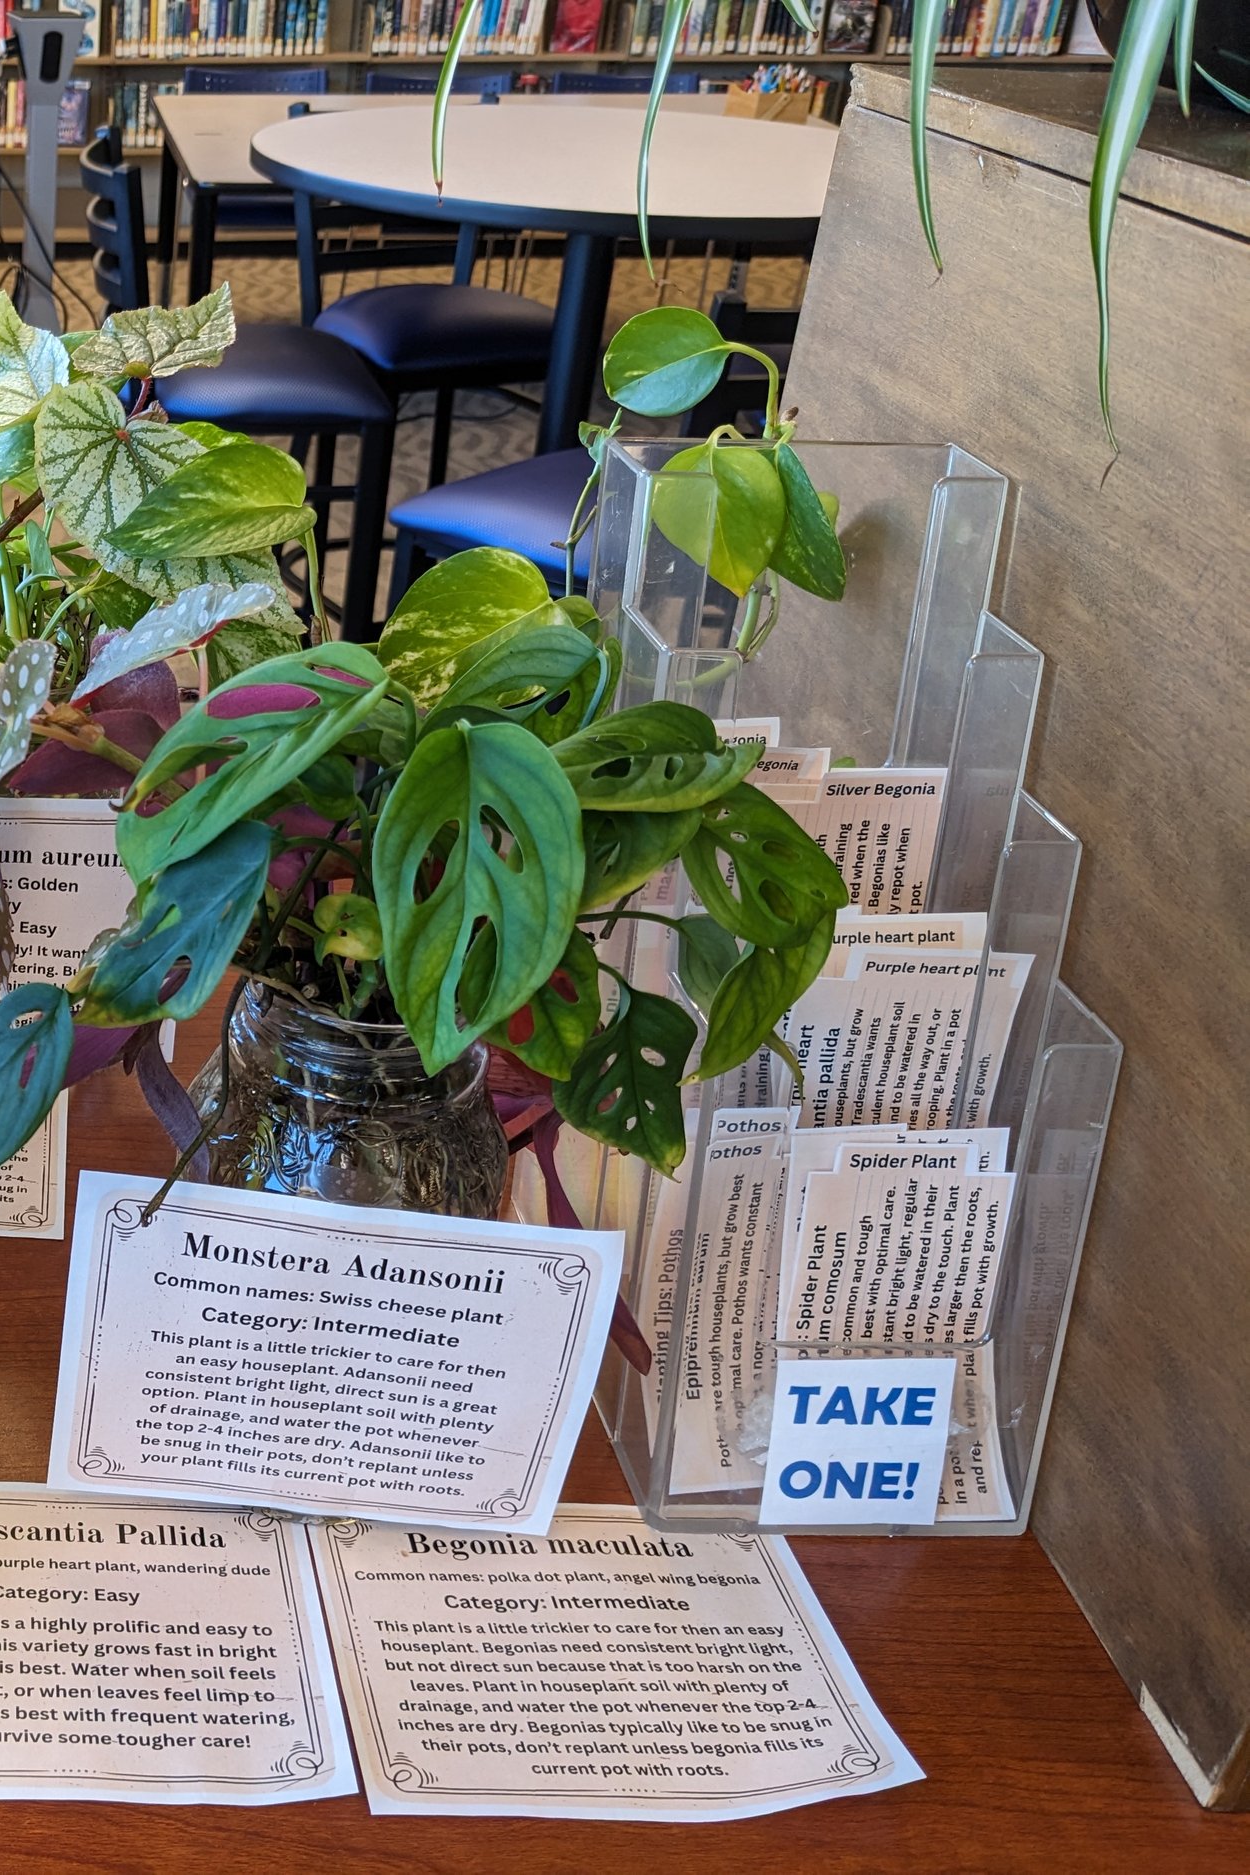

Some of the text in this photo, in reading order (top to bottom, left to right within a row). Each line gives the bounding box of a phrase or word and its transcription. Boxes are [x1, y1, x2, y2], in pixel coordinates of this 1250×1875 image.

[826, 782, 936, 799] Silver Begonia
[868, 823, 891, 907] Begonias like
[18, 877, 78, 893] Golden
[20, 921, 58, 938] Easy
[833, 929, 956, 947] urple heart plant
[865, 961, 1007, 977] Purple heart plnt
[818, 1027, 841, 1084] pallida
[717, 1119, 782, 1133] Pothos
[849, 1153, 958, 1172] Spider Plant
[16, 1185, 28, 1194] in
[180, 1231, 505, 1294] Monstera Adansonii
[860, 1186, 897, 1338] best with optimal care.
[923, 1185, 960, 1335] dry to the touch. Plant
[796, 1224, 828, 1330] Spider Plant
[154, 1271, 504, 1326] Common names: Swiss cheese plant
[202, 1306, 460, 1348] Category: Intermediate
[788, 1385, 936, 1426] TAKE
[135, 1418, 487, 1467] the top 2-4 inches are dry. Adansonii like to
[779, 1460, 920, 1500] ONE!
[115, 1523, 229, 1548] Pallida
[403, 1532, 694, 1561] Begonia maculata
[49, 1558, 92, 1570] heart
[95, 1560, 141, 1575] plant,
[144, 1562, 228, 1578] wandering
[231, 1564, 271, 1576] dude
[354, 1570, 762, 1587] Common names: polka dot plant, angel wing begonia
[94, 1588, 140, 1606] Easy
[444, 1594, 690, 1613] Category: Intermediate
[58, 1733, 111, 1746] some
[117, 1733, 197, 1752] tougher
[201, 1734, 251, 1748] care!
